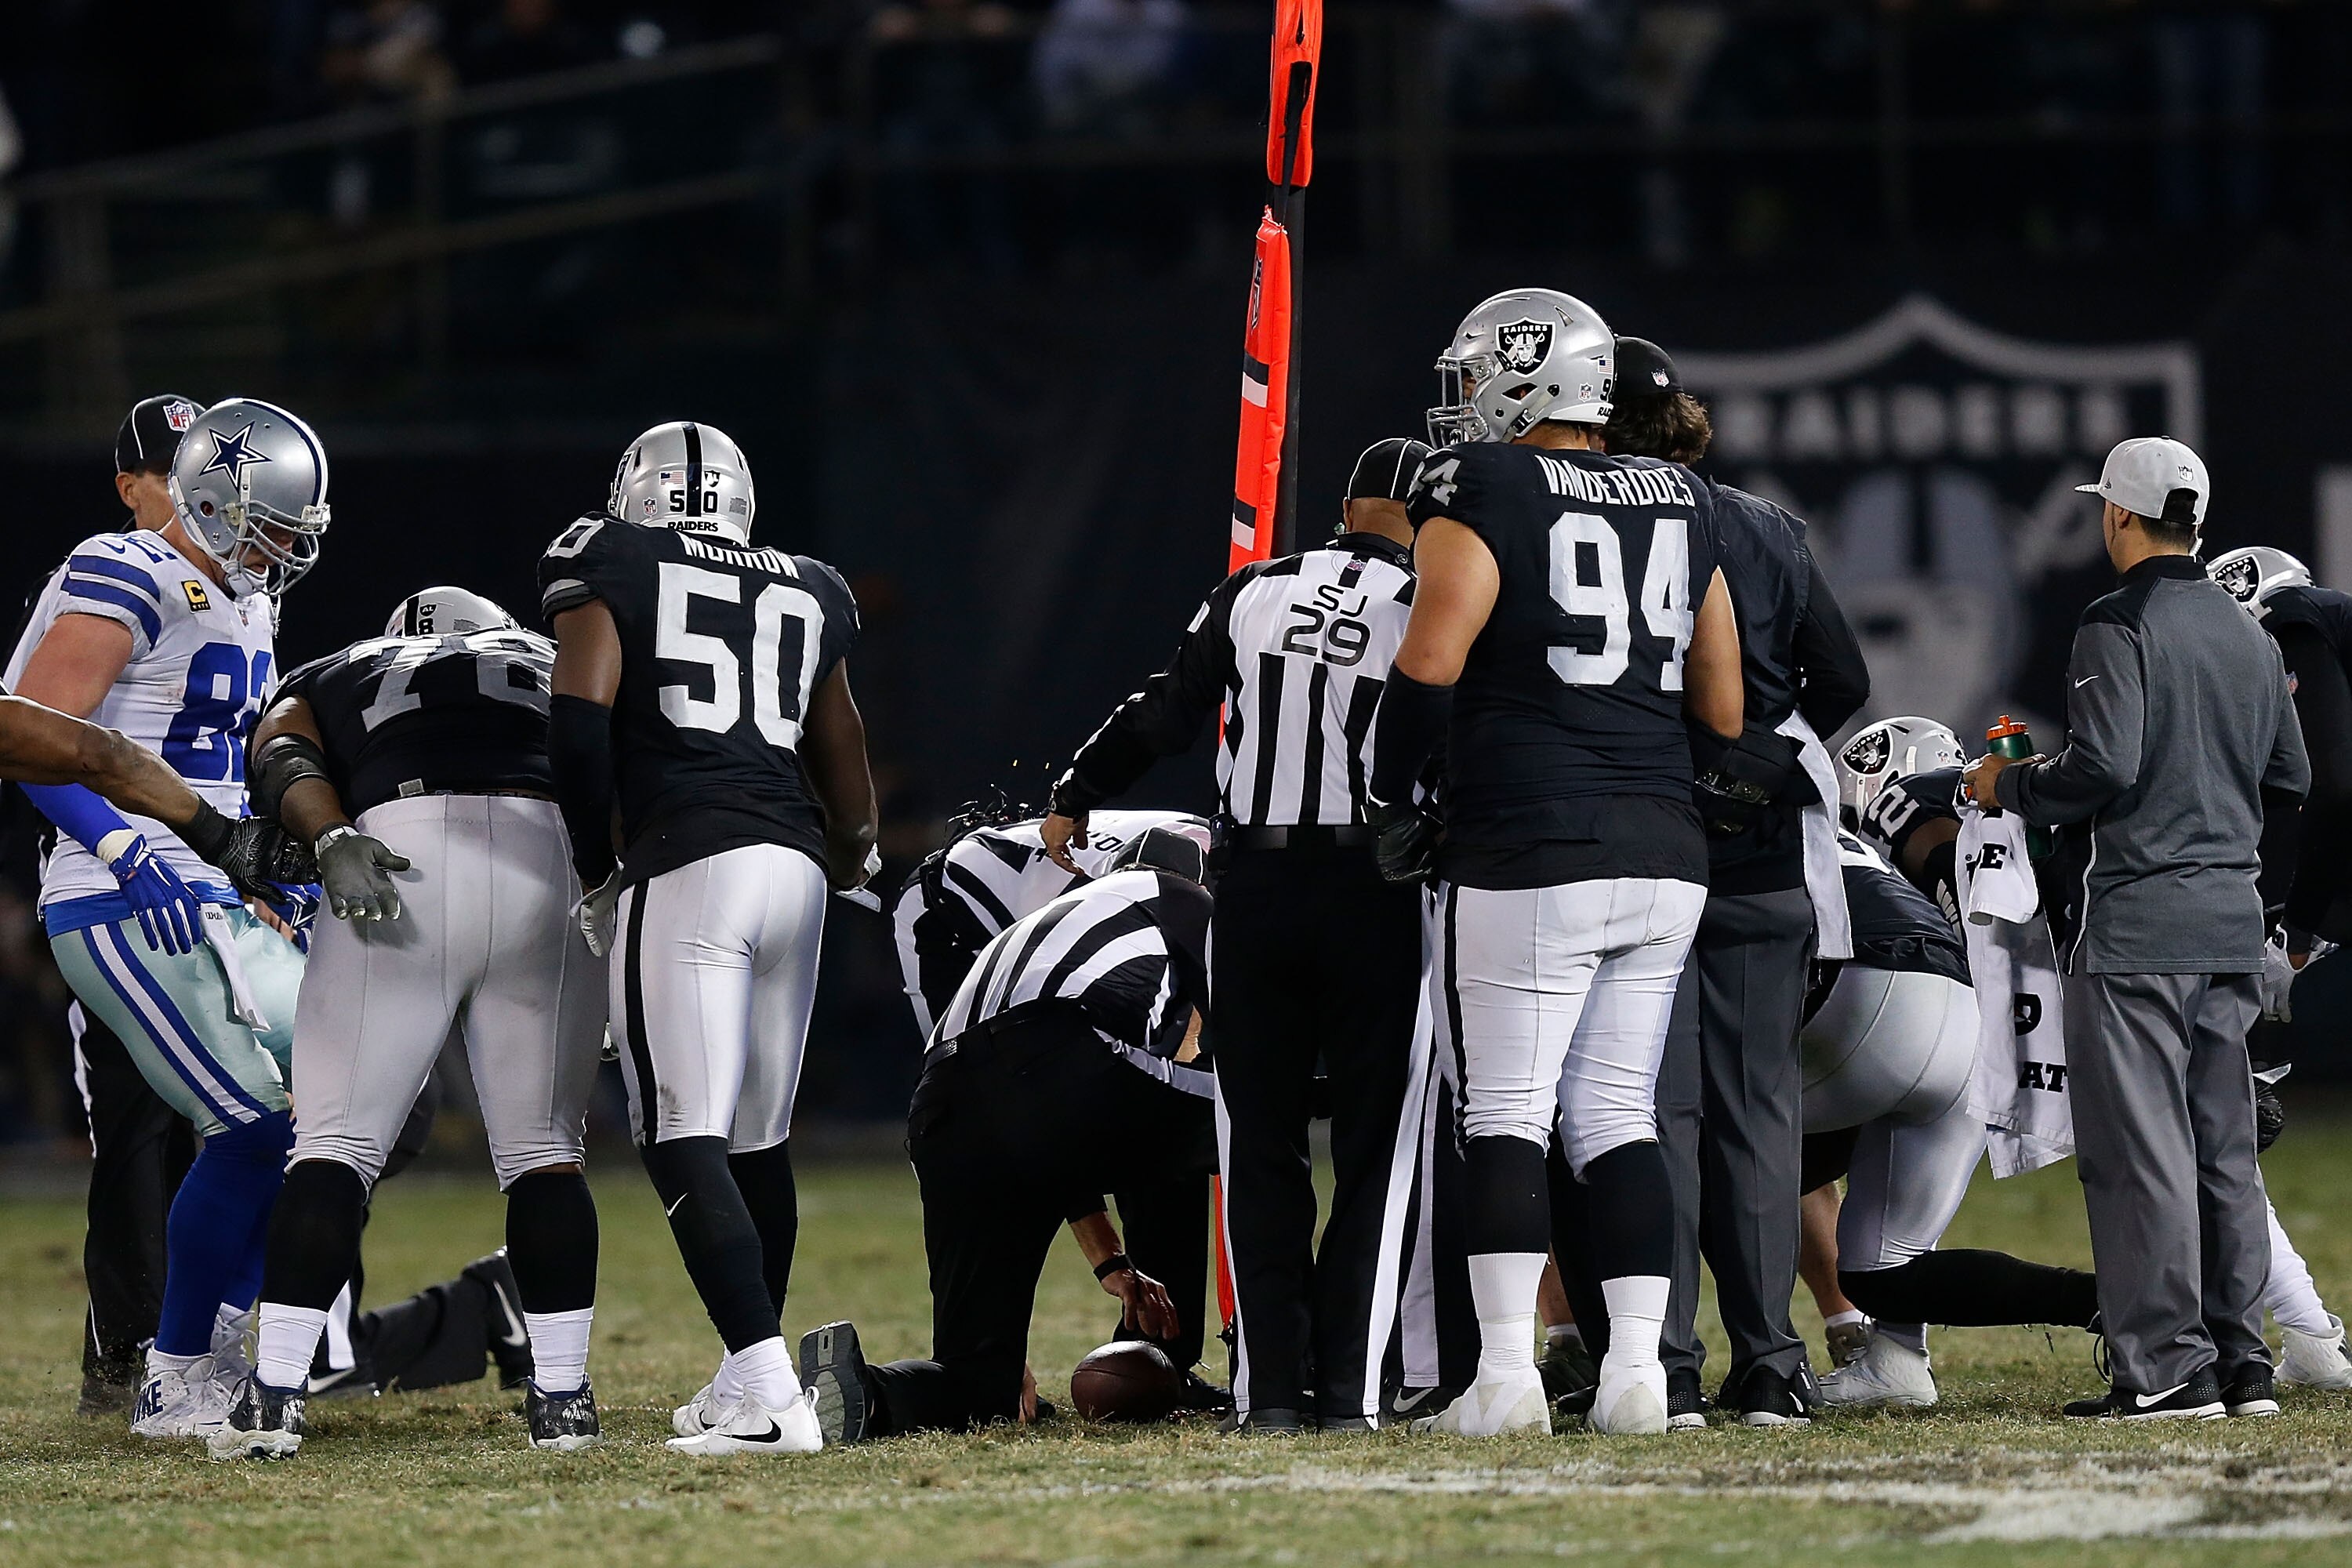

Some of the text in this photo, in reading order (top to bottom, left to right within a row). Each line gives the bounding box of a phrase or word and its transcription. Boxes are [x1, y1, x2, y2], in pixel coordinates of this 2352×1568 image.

[1503, 325, 1548, 333] RAIDERS
[1534, 454, 1696, 507] VANDERDOES
[667, 521, 719, 532] RAIDERS
[2216, 558, 2249, 578] AIDERS
[183, 580, 206, 604] C
[422, 604, 434, 613] AL
[1312, 584, 1369, 618] SJ
[1547, 511, 1693, 691] 94
[1281, 603, 1371, 667] 29
[655, 561, 825, 754] 50
[132, 1379, 163, 1425] IKE
